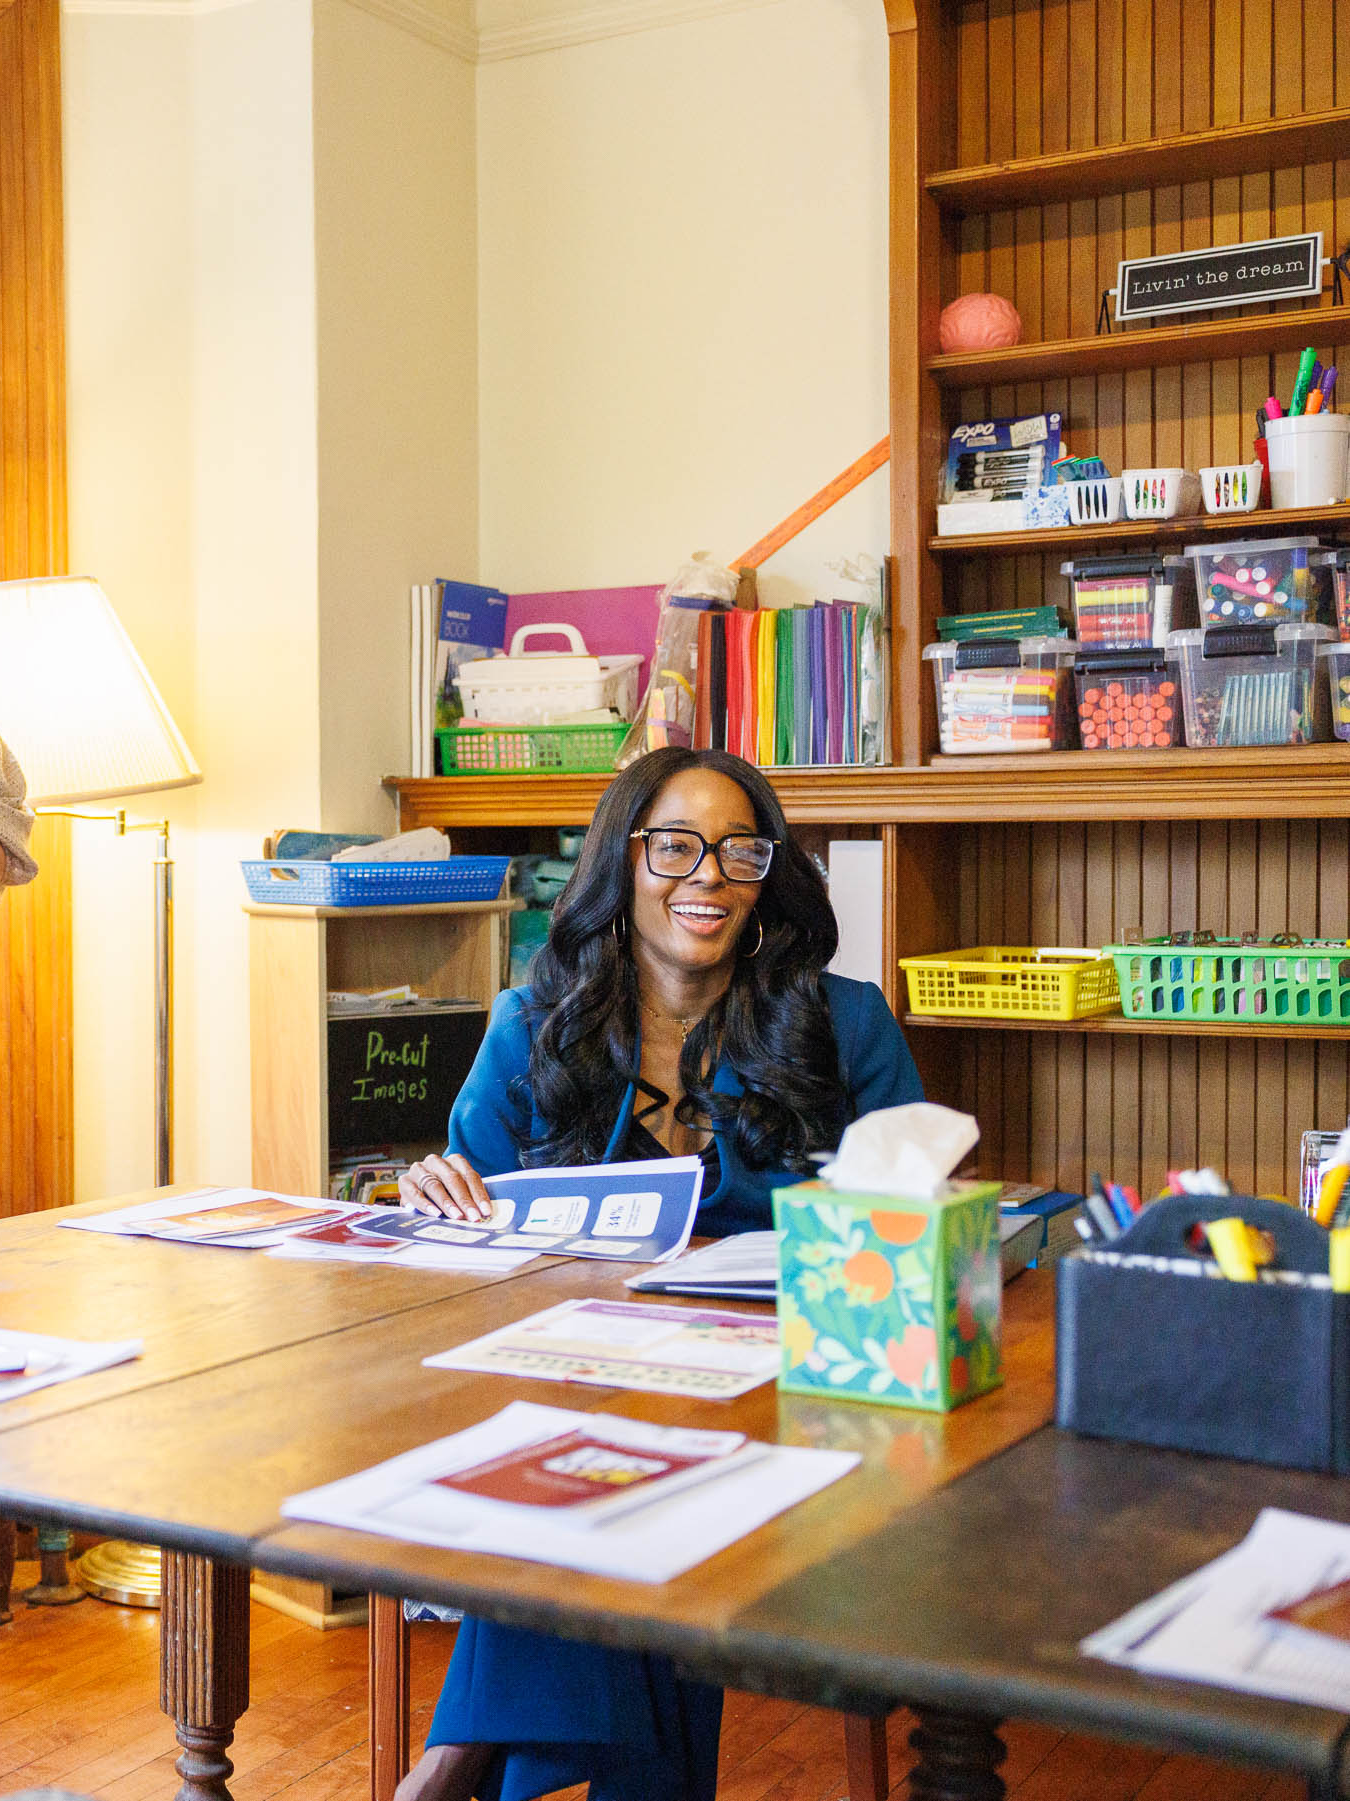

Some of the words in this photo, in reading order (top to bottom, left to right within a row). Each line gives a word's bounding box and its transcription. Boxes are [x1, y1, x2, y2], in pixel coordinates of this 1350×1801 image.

[1133, 273, 1191, 296] Livin'
[1196, 267, 1229, 286] the
[1236, 258, 1305, 280] dream
[952, 422, 995, 443] EXPO
[351, 1077, 428, 1104] Images
